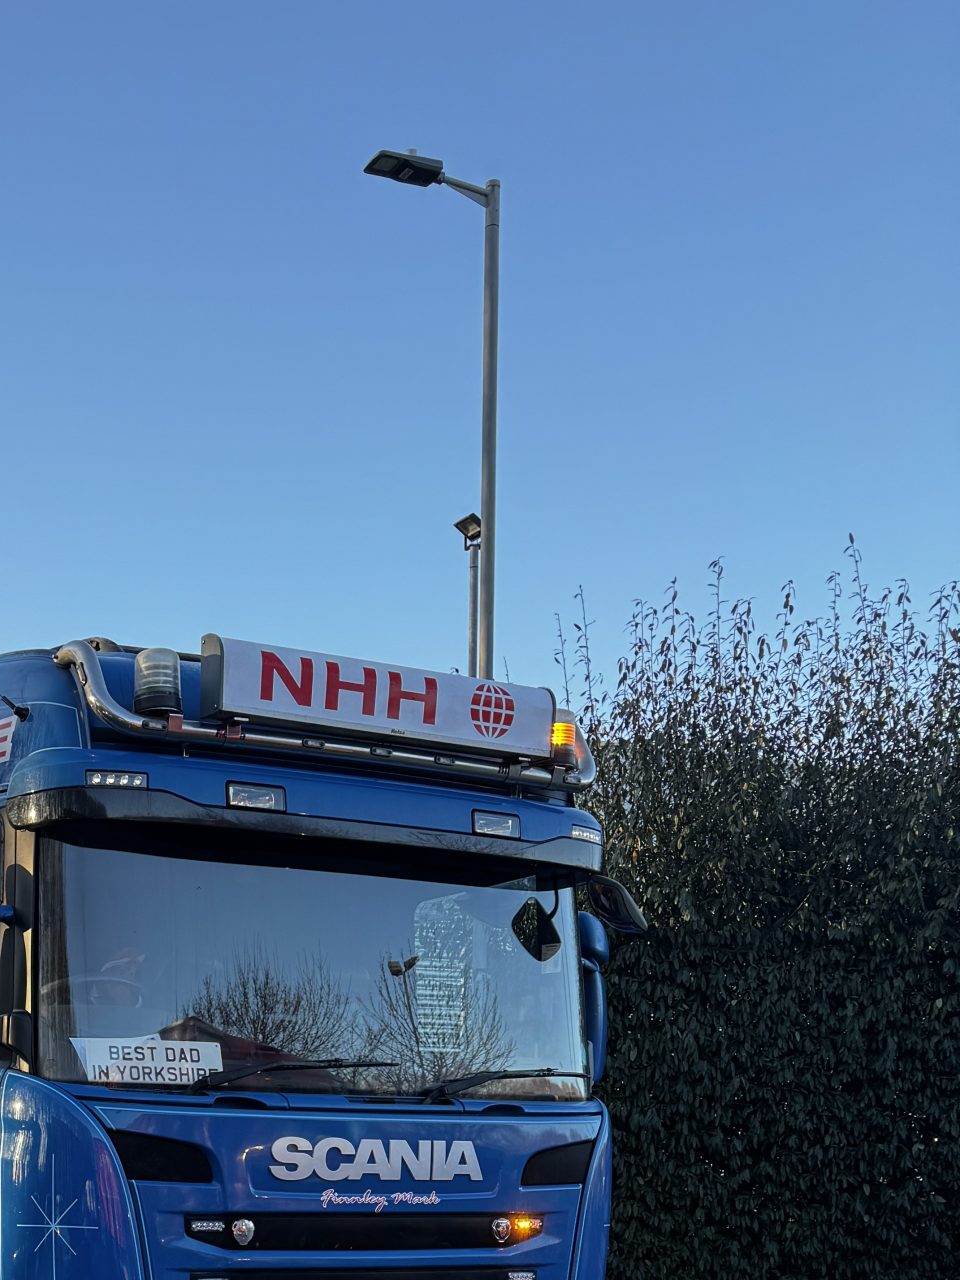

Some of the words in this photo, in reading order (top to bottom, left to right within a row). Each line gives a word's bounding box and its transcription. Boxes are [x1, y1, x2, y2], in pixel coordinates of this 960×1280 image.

[260, 650, 438, 725] NHH
[109, 1045, 157, 1062] BEST
[165, 1048, 201, 1063] DAD
[92, 1065, 110, 1080] IN
[269, 1136, 483, 1181] SCANIA
[320, 1188, 388, 1213] Finnley
[390, 1190, 440, 1205] Mark
